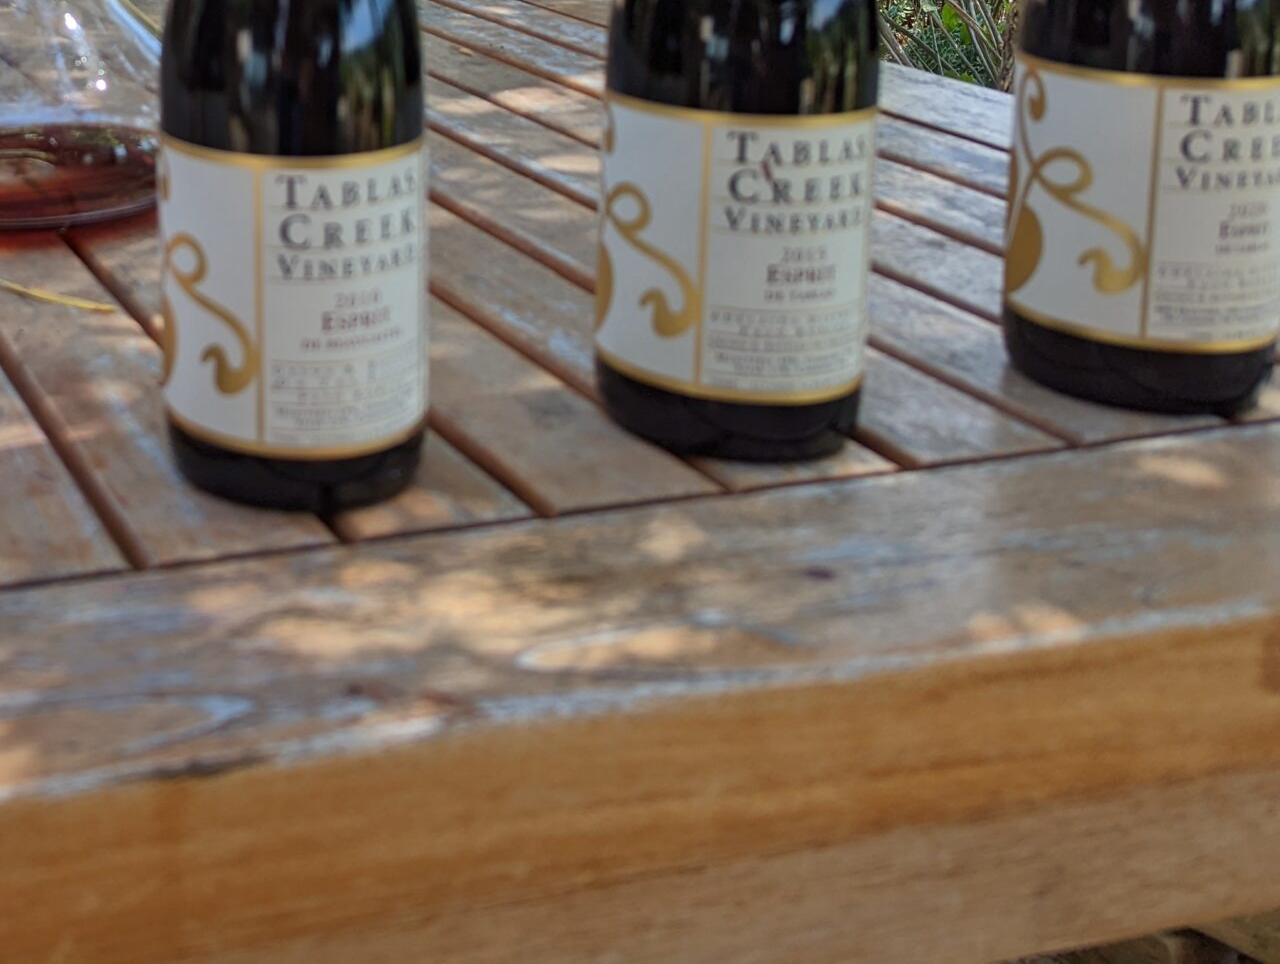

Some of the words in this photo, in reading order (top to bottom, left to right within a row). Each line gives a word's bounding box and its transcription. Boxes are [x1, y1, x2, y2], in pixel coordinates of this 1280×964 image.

[1180, 94, 1280, 126] TABL
[727, 130, 866, 166] TABLAS
[1180, 129, 1280, 164] CREE
[275, 167, 417, 211] TABLAS
[727, 167, 864, 205] CREEK
[278, 208, 416, 251] CREEK
